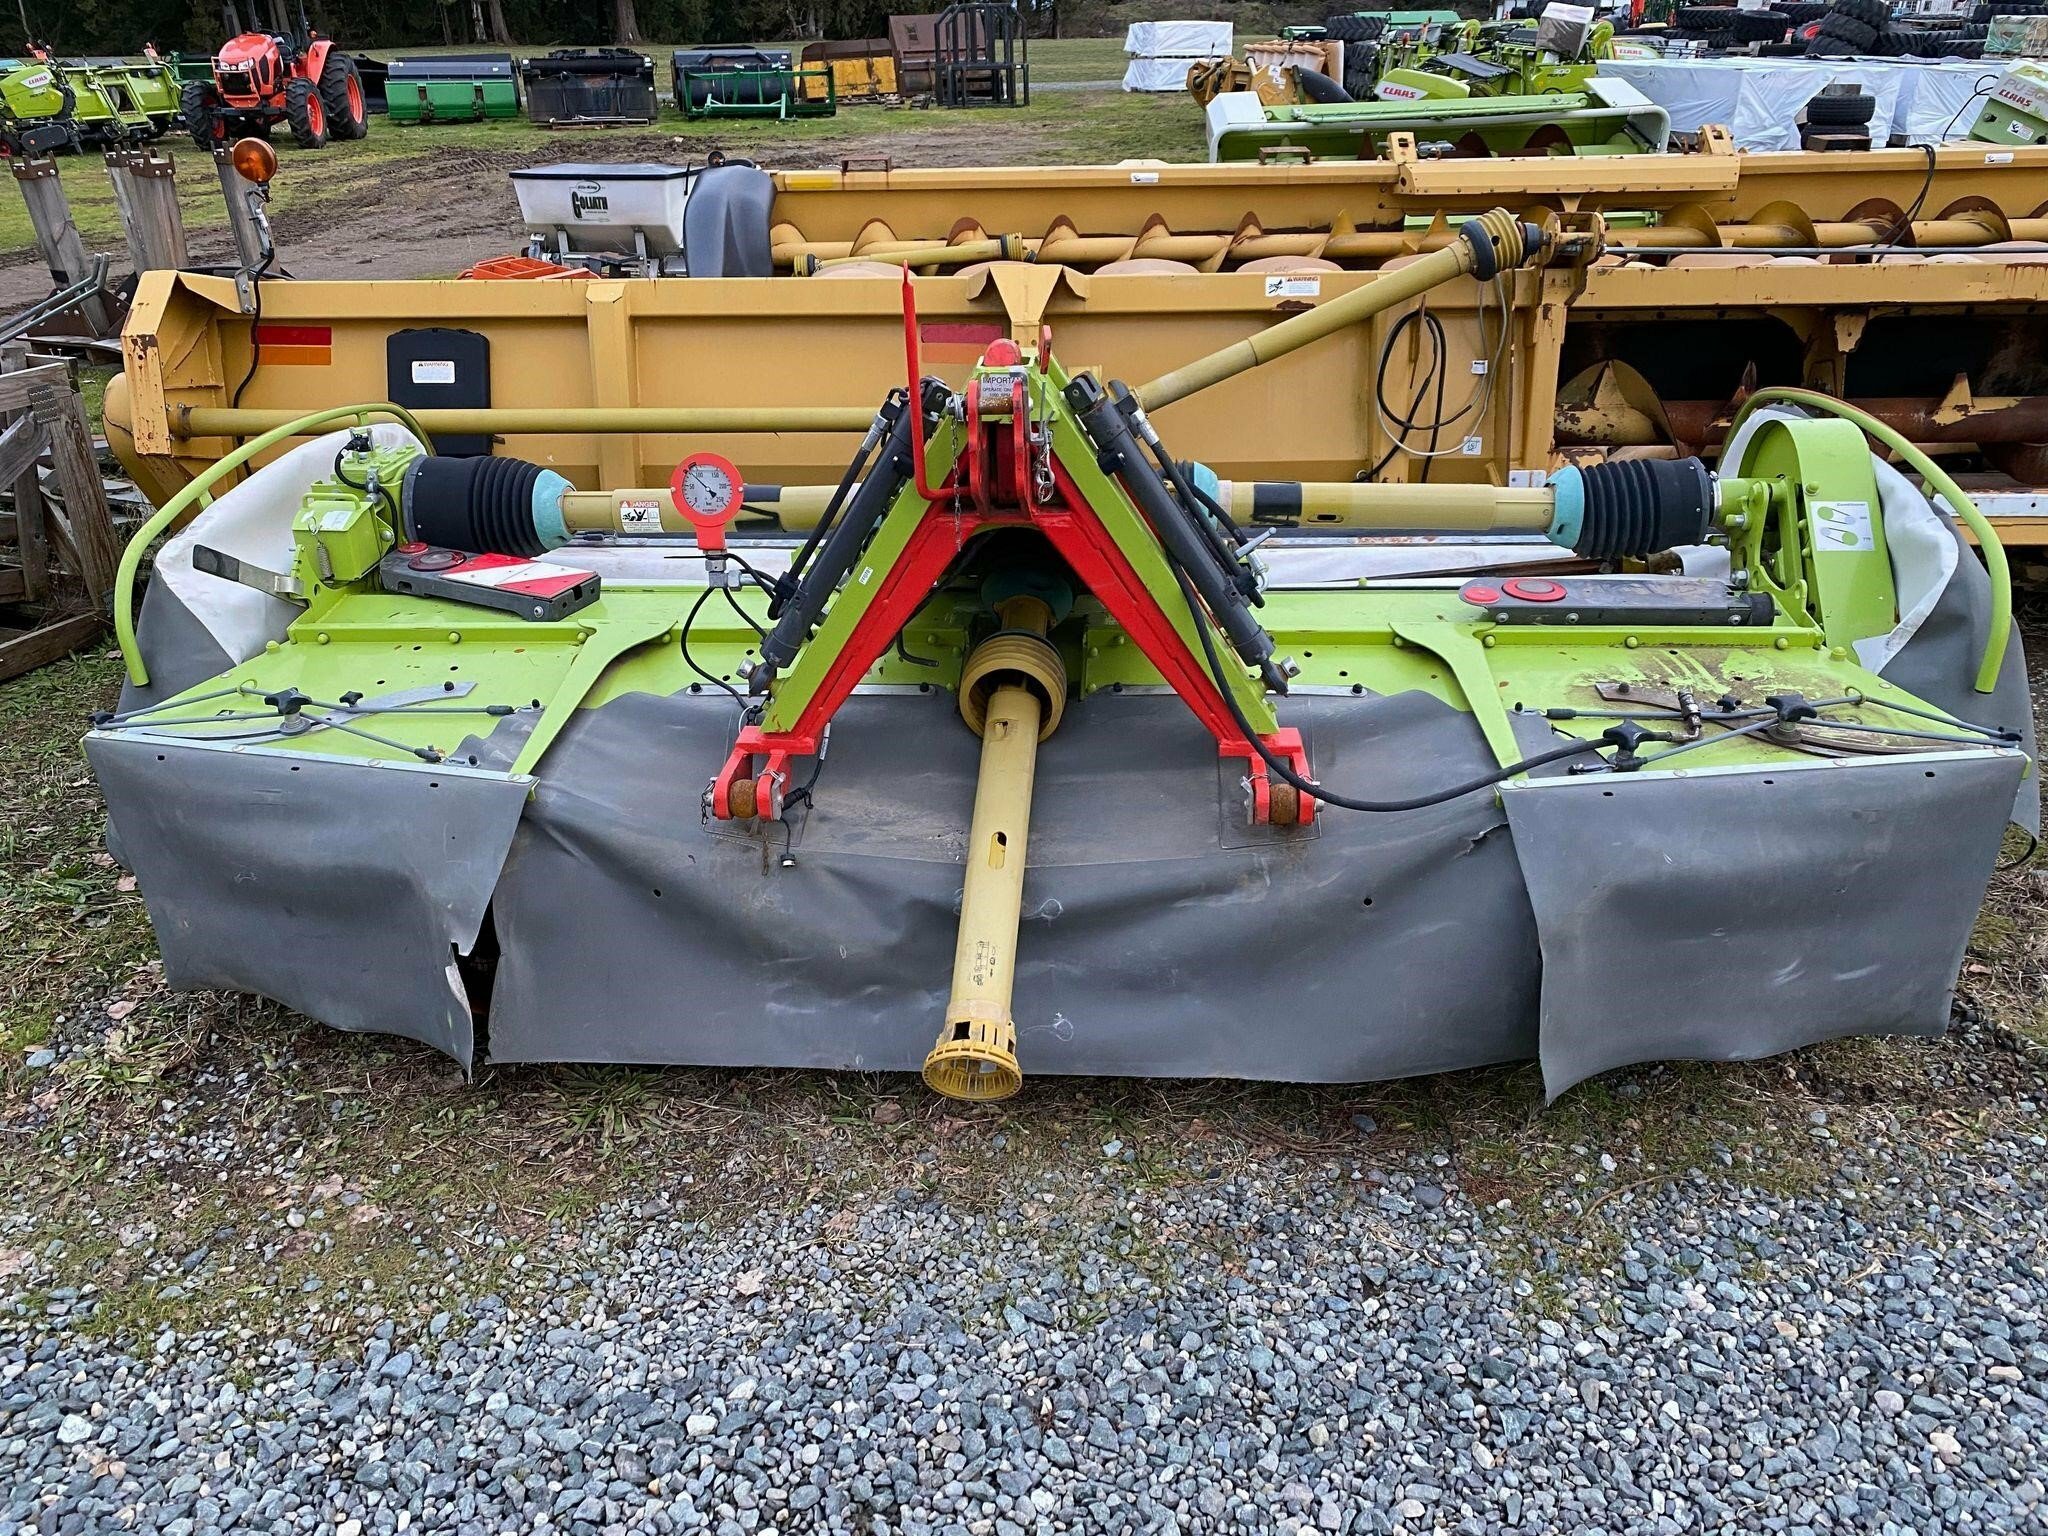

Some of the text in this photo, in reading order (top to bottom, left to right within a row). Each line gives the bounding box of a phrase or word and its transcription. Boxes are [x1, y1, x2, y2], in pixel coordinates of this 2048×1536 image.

[1382, 86, 1417, 99] CLAAS
[1998, 88, 2033, 107] CLAAS
[571, 191, 608, 219] GOLIATH
